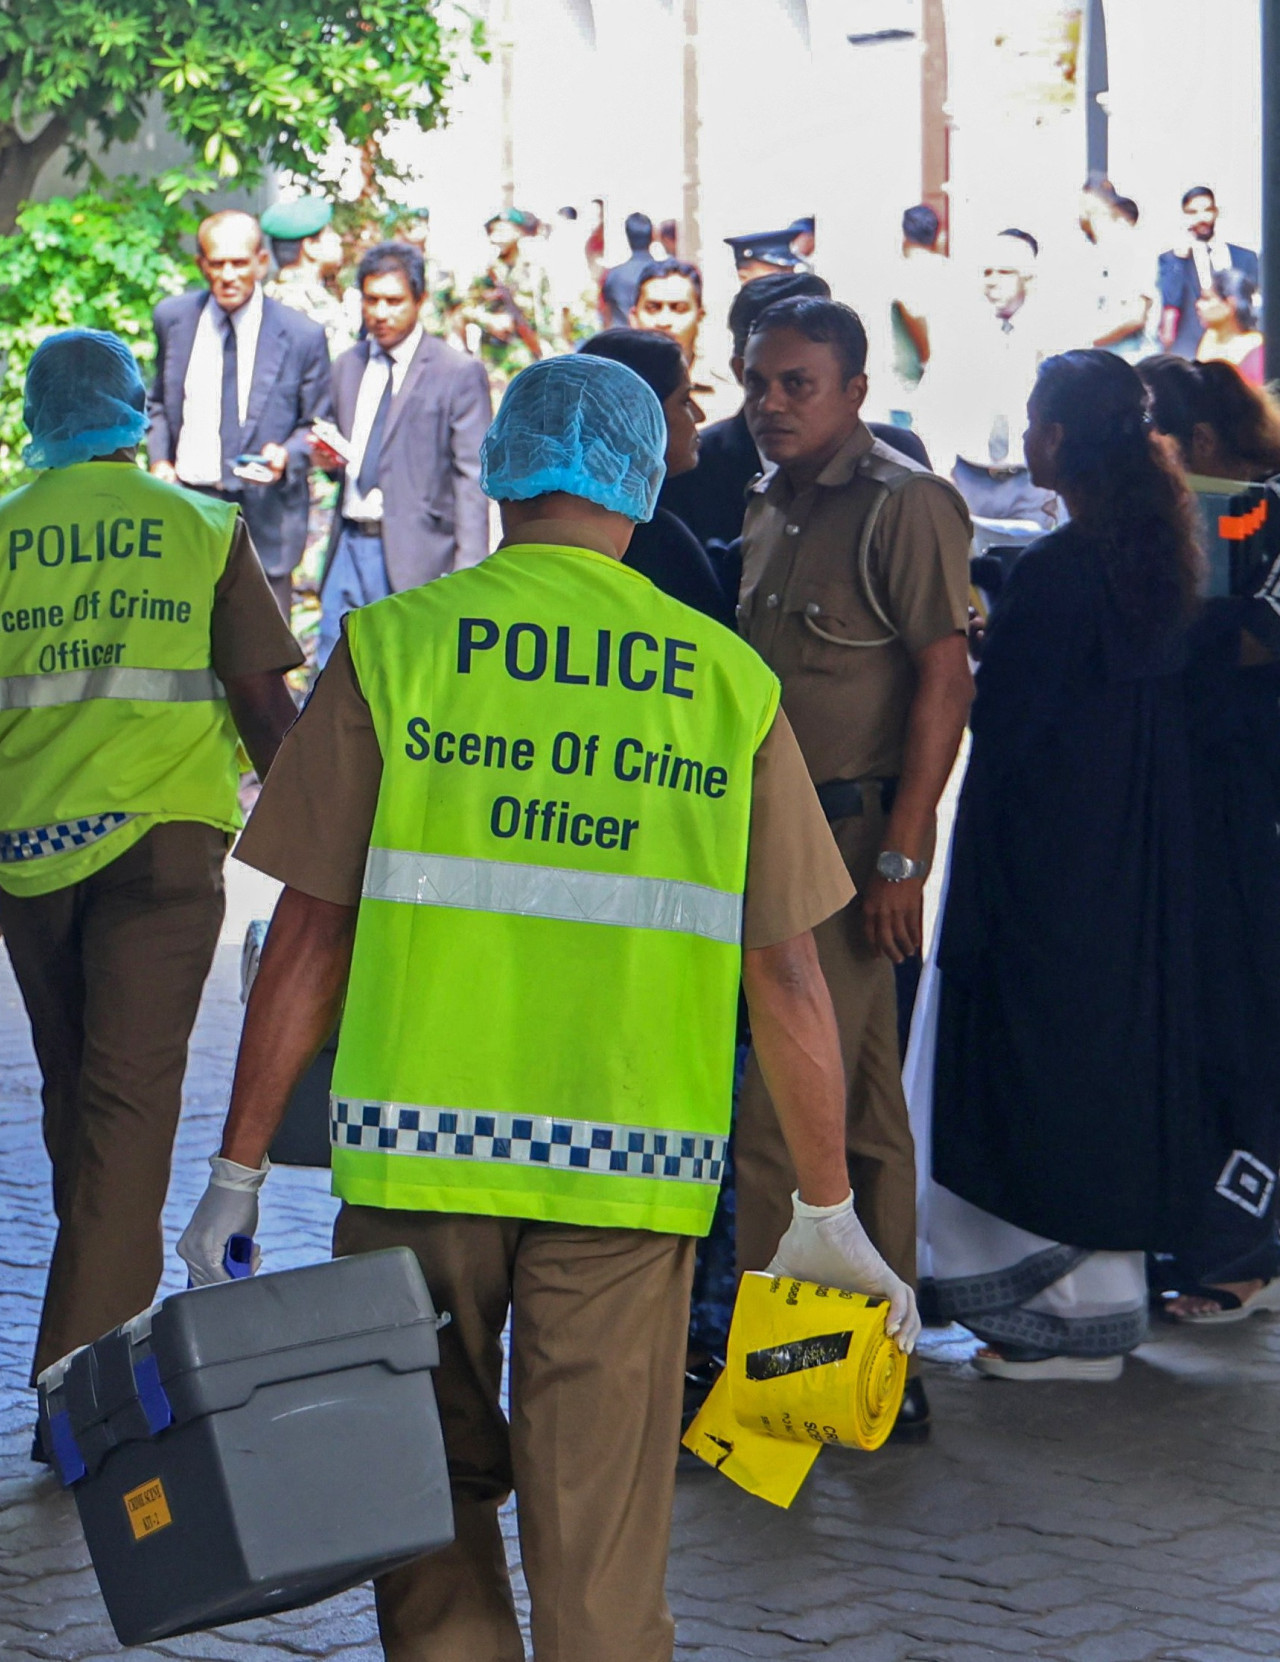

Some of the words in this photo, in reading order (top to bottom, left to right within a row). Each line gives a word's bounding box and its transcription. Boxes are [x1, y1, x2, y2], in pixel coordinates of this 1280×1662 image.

[9, 518, 163, 571] POLICE
[74, 591, 100, 622] Of
[109, 588, 192, 624] Crime
[38, 639, 126, 673] Officer
[456, 617, 698, 700] POLICE
[404, 716, 535, 771] Scene
[551, 730, 600, 777] Of
[613, 737, 728, 799] Crime
[490, 795, 640, 851] Officer
